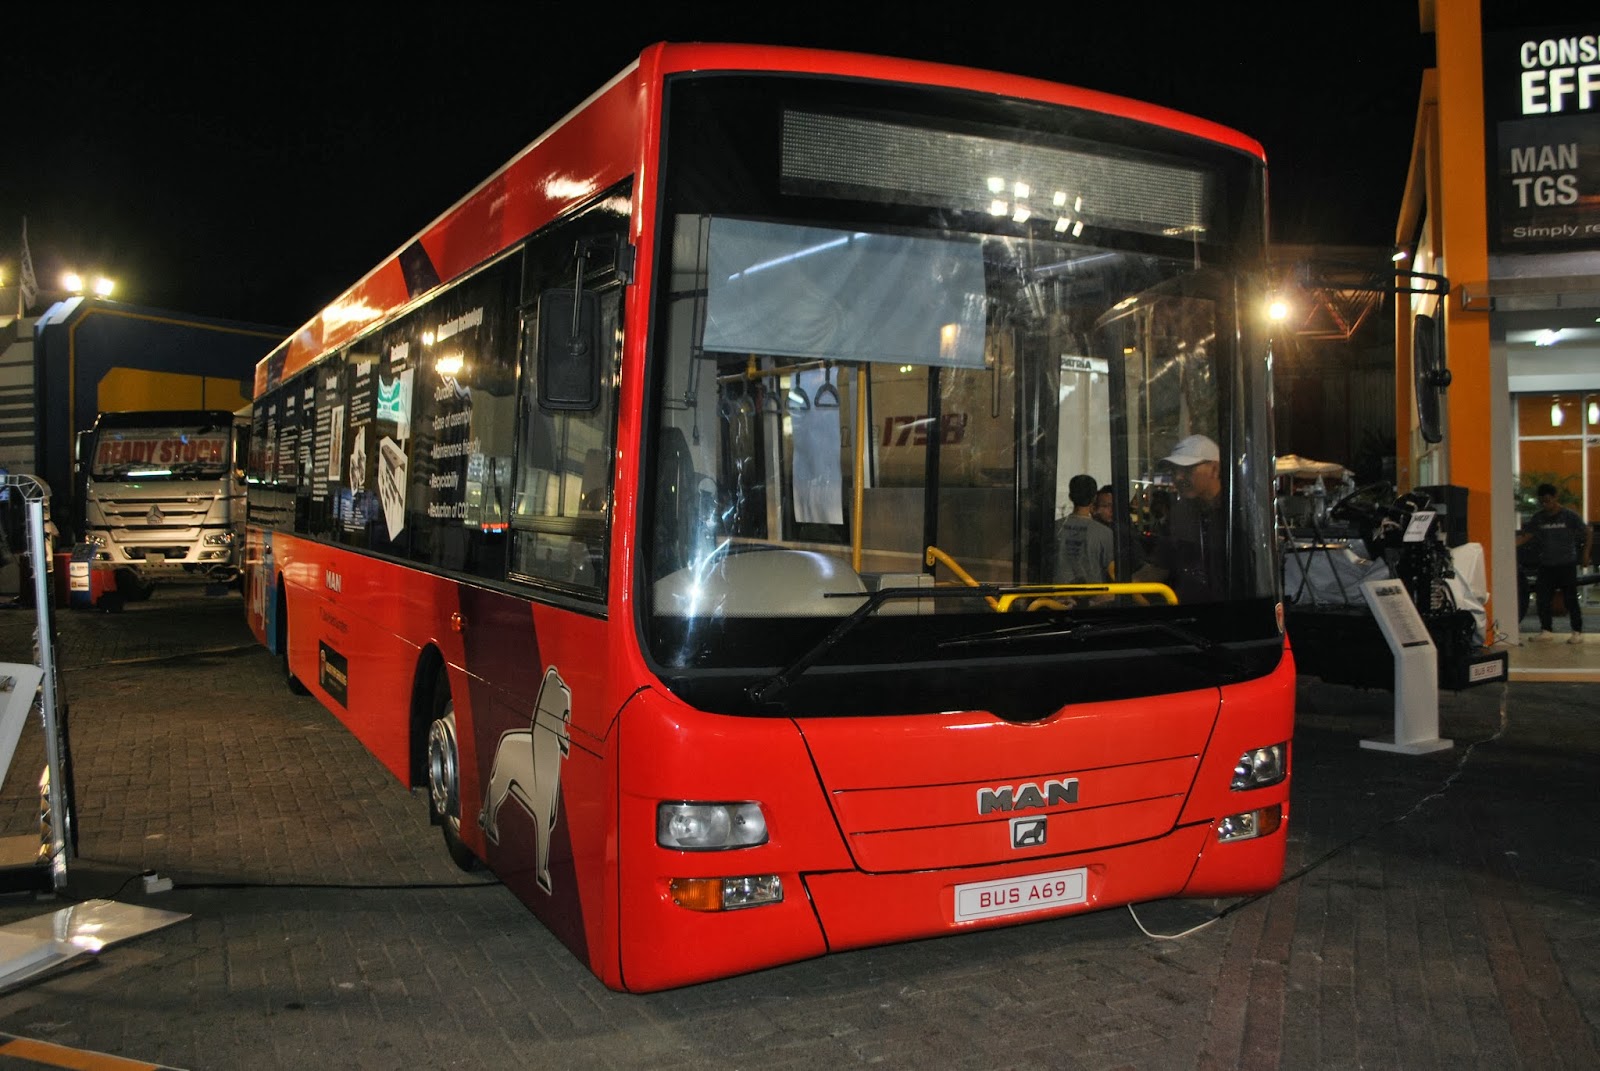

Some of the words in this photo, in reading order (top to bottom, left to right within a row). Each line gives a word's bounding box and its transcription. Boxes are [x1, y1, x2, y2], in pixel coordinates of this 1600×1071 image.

[1521, 64, 1600, 115] EFF
[1511, 143, 1578, 174] MAN
[1512, 174, 1578, 208] TGS
[1513, 224, 1578, 238] Simply
[98, 441, 157, 464] READY
[160, 440, 225, 463] STOCK
[325, 569, 342, 593] MAN
[977, 778, 1079, 815] MAN
[980, 888, 1020, 908] BUS
[1028, 881, 1066, 901] A69
